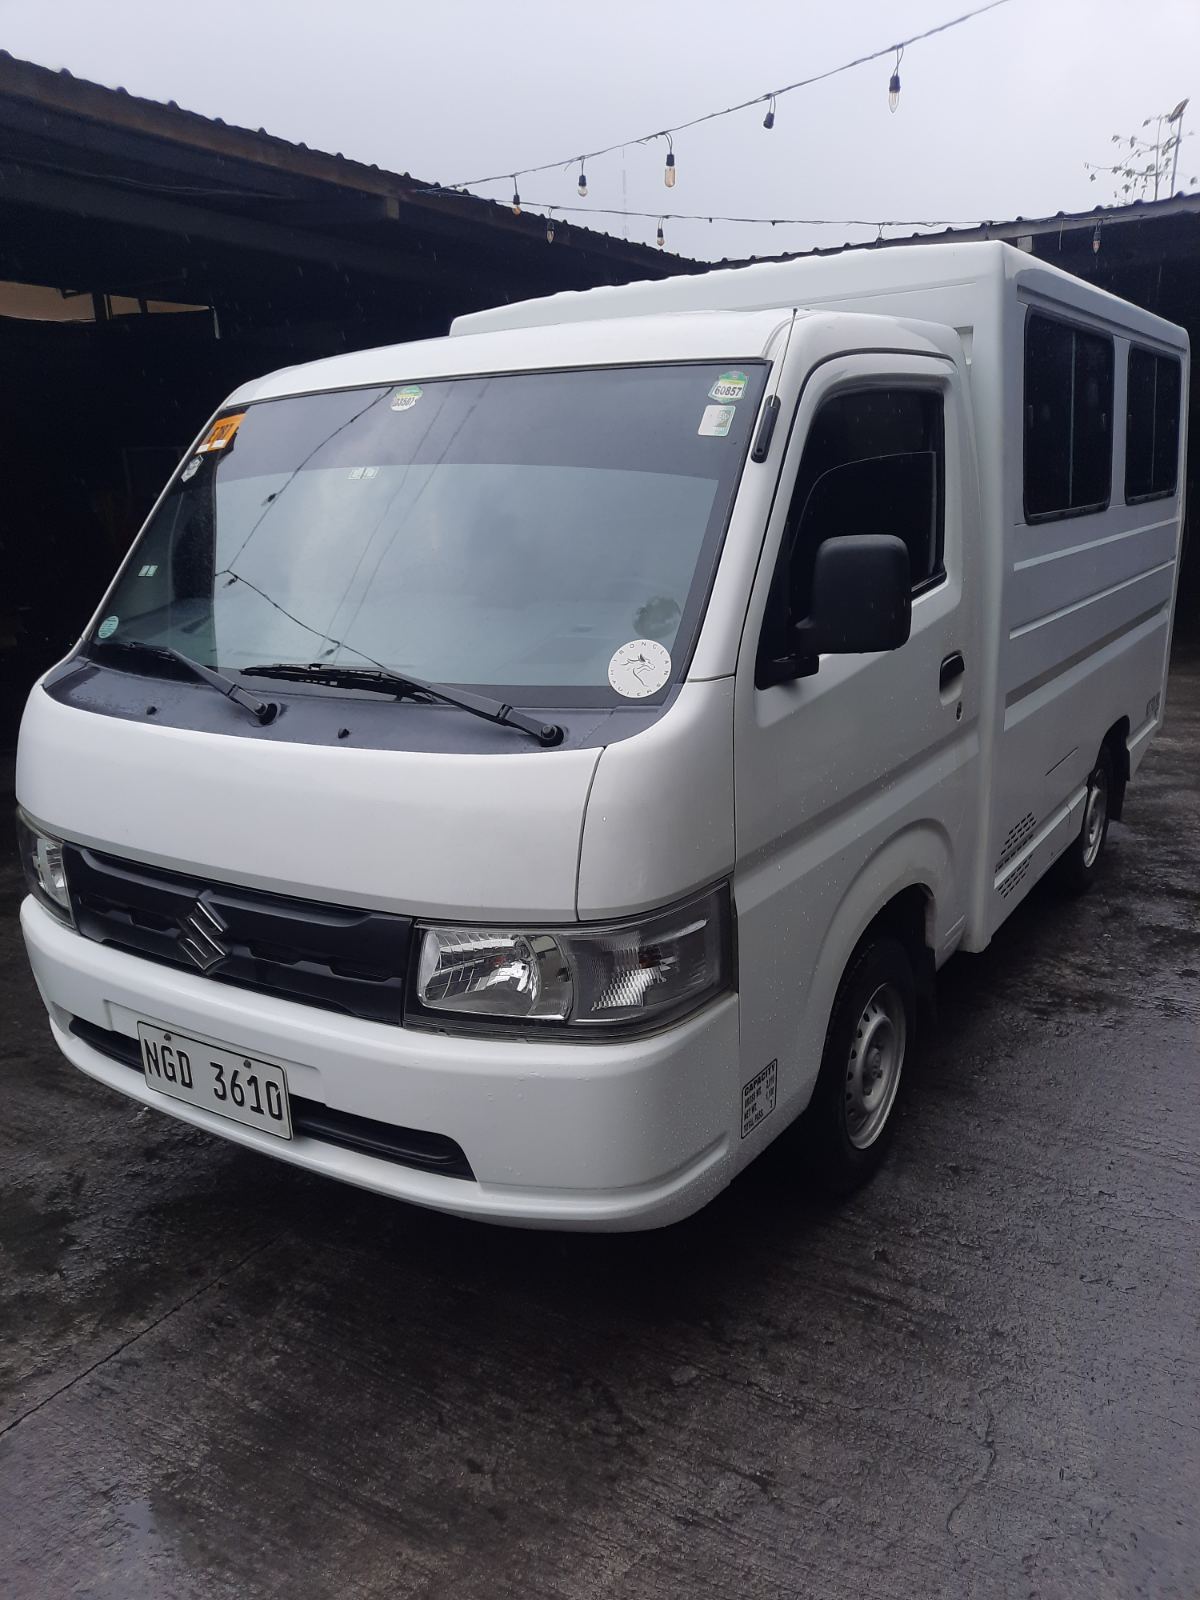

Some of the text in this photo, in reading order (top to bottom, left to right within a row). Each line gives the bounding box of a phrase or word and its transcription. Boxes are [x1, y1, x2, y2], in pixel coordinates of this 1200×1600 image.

[714, 386, 742, 396] 60857
[144, 1038, 283, 1121] NGD 3610
[744, 1063, 775, 1096] CAPACITY
